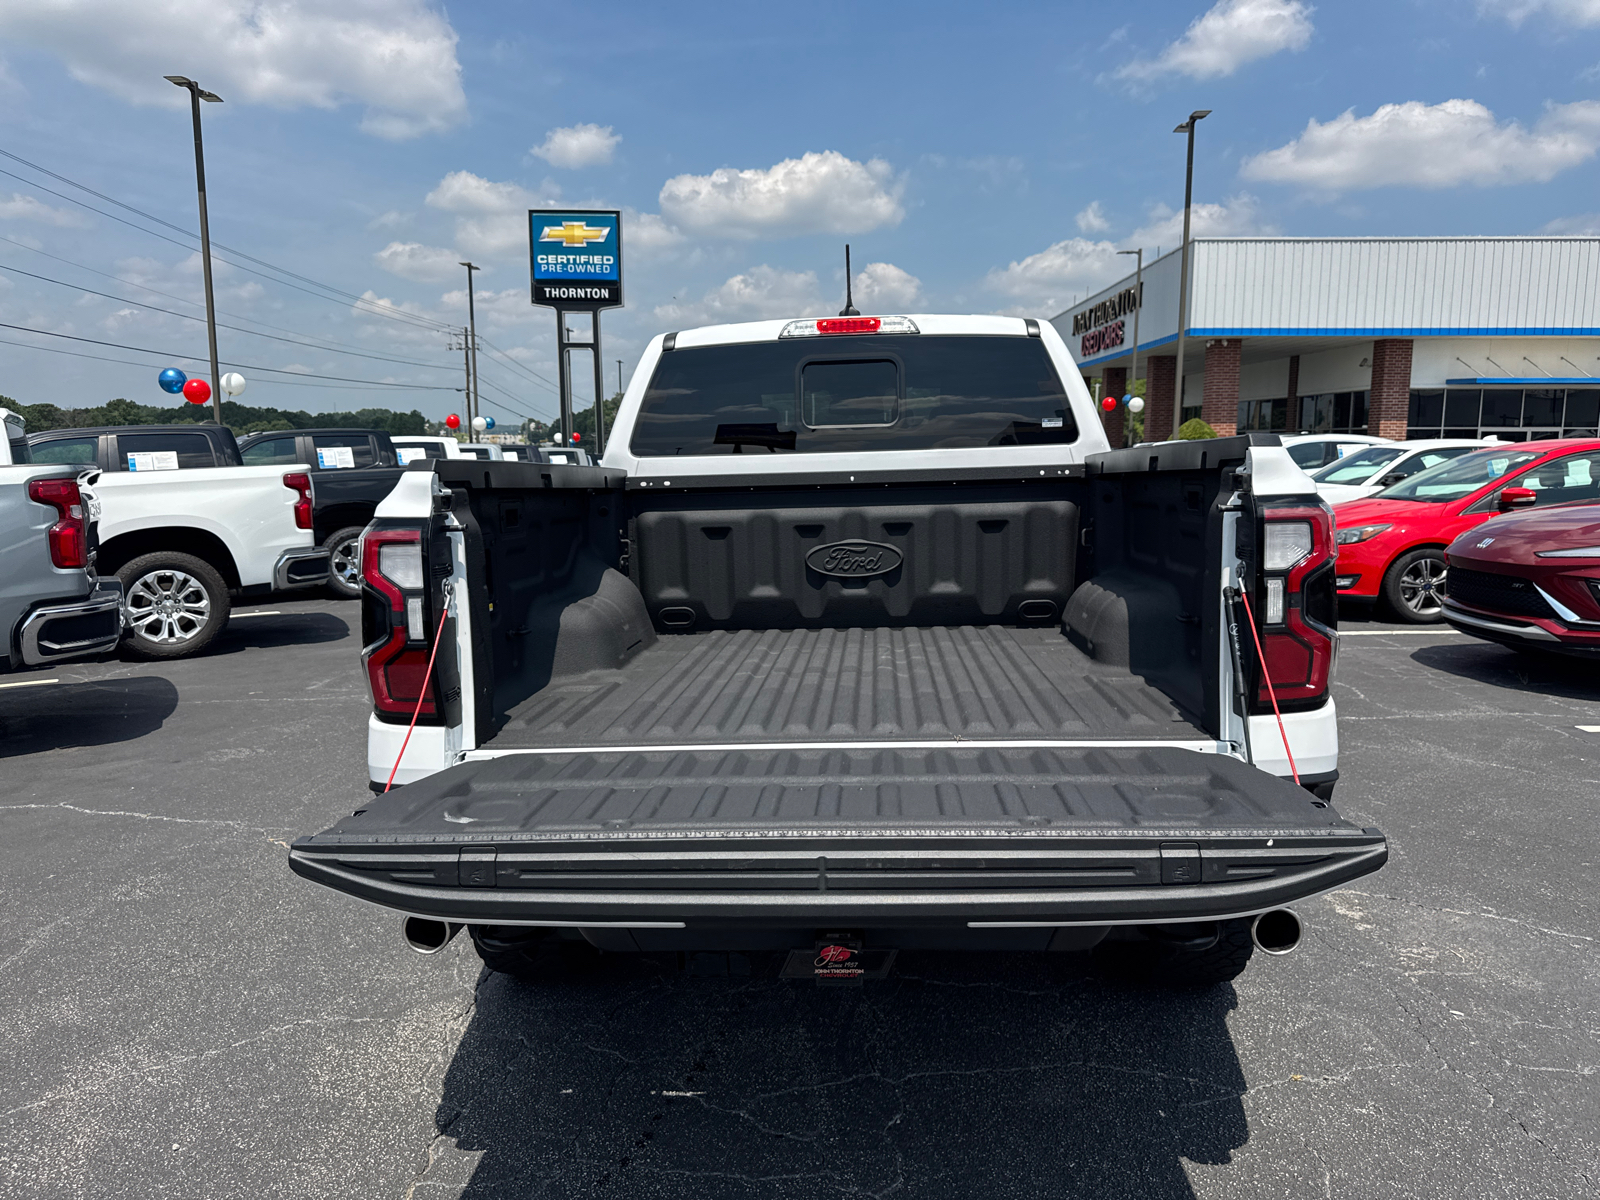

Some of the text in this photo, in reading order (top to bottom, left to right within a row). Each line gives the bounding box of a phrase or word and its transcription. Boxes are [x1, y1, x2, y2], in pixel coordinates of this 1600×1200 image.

[537, 255, 614, 264] CERTIFIED
[541, 264, 610, 273] PRE-OWNED
[544, 287, 609, 298] THORNTON
[1081, 321, 1125, 356] USED CARS
[823, 546, 883, 571] Ford
